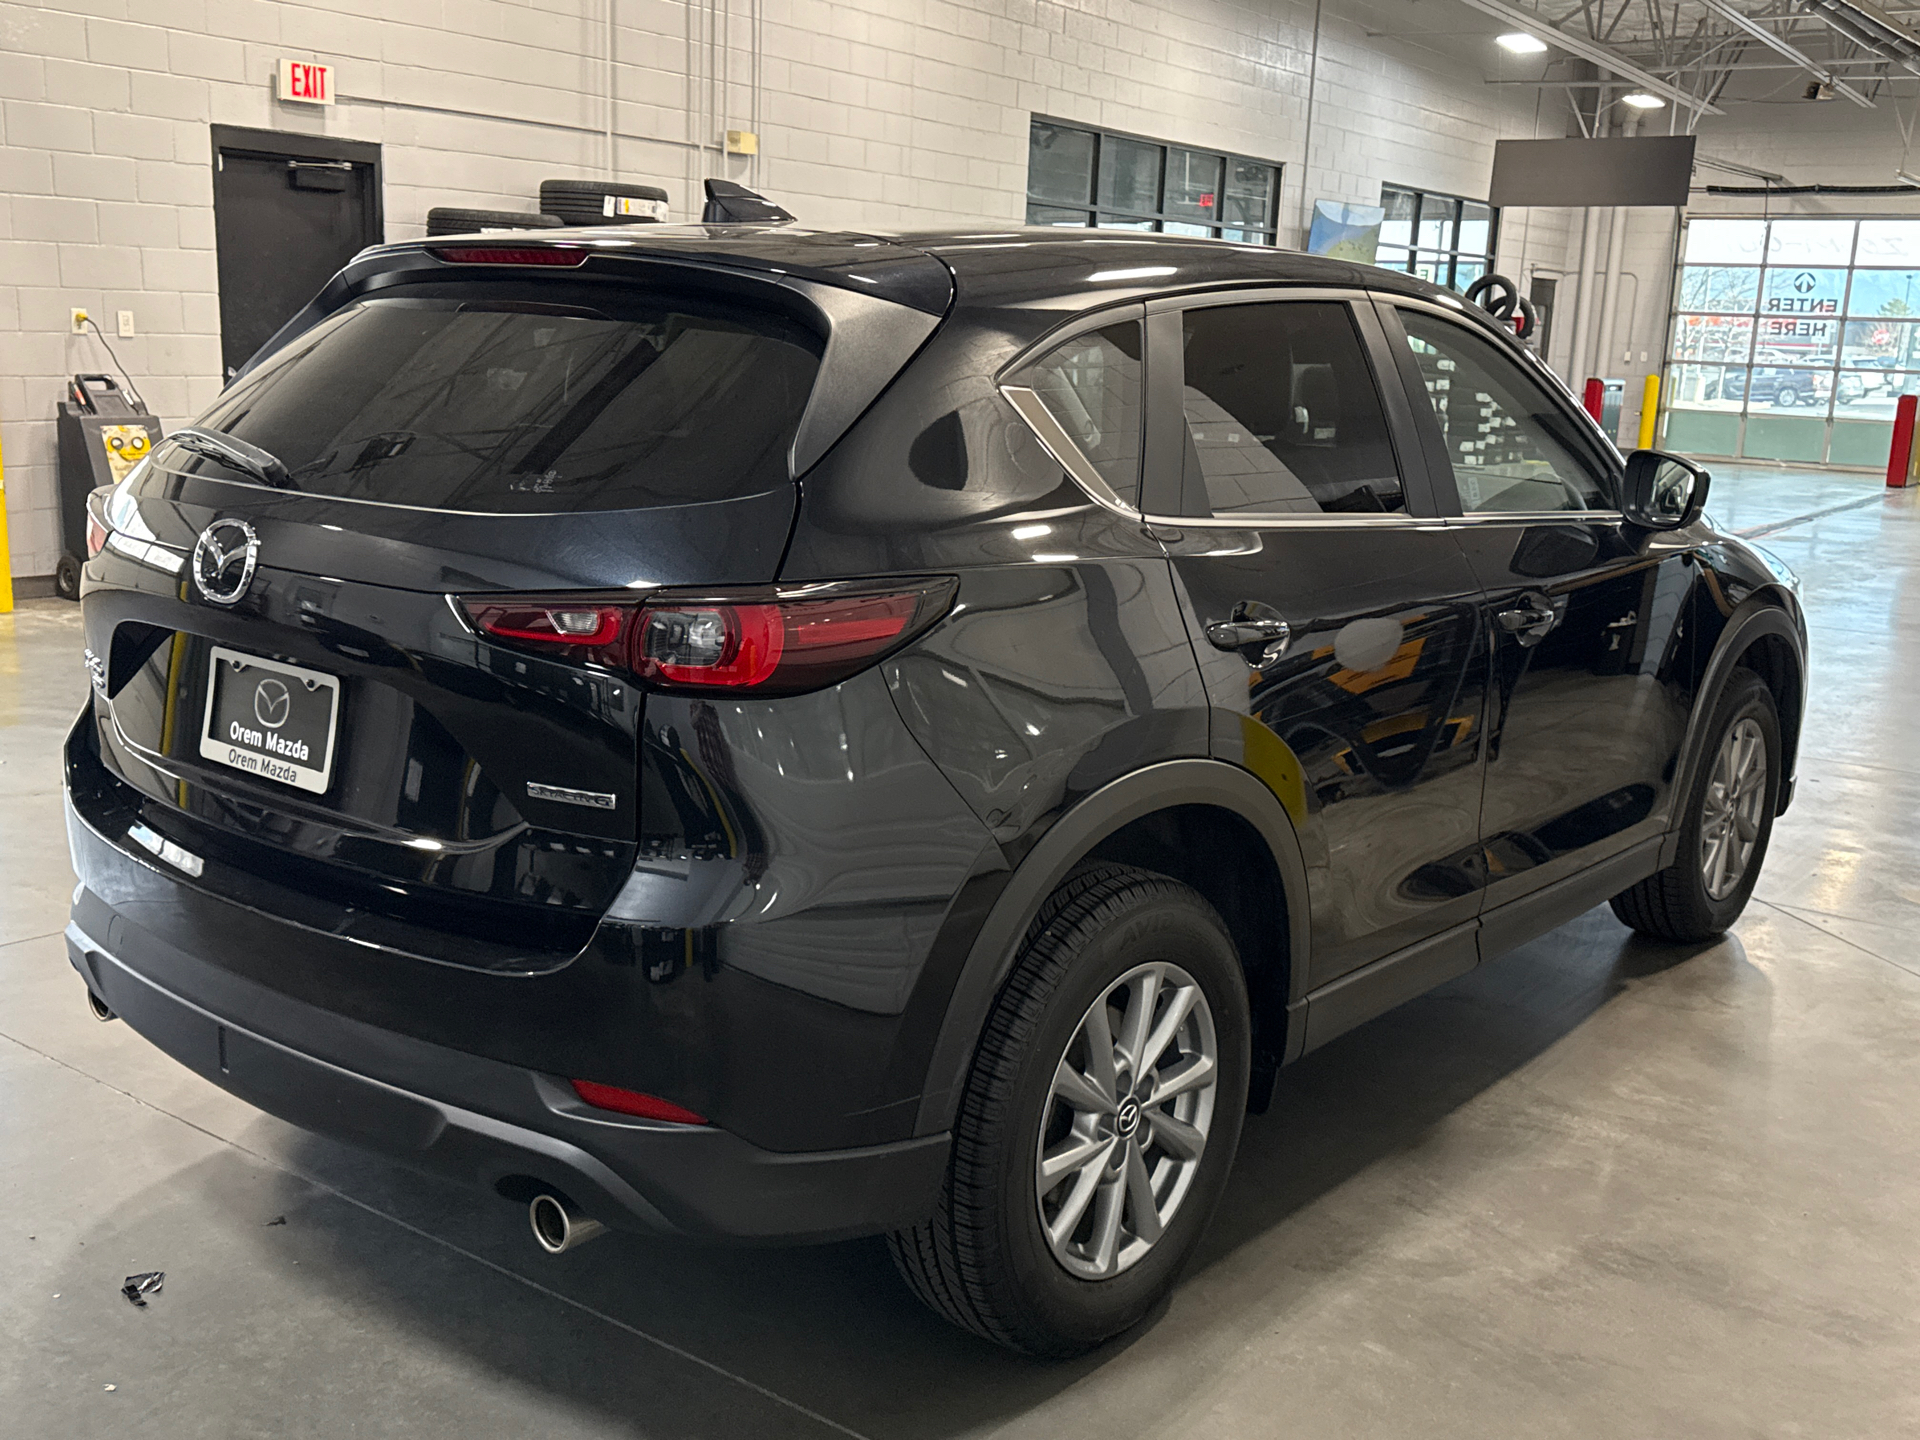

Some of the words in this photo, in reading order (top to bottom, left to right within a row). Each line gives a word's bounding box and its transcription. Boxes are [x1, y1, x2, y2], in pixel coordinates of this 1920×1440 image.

[291, 63, 327, 100] EXIT
[229, 720, 263, 748] Orem
[265, 731, 309, 761] Mazda
[228, 748, 258, 771] Orem
[260, 758, 297, 783] Mazda
